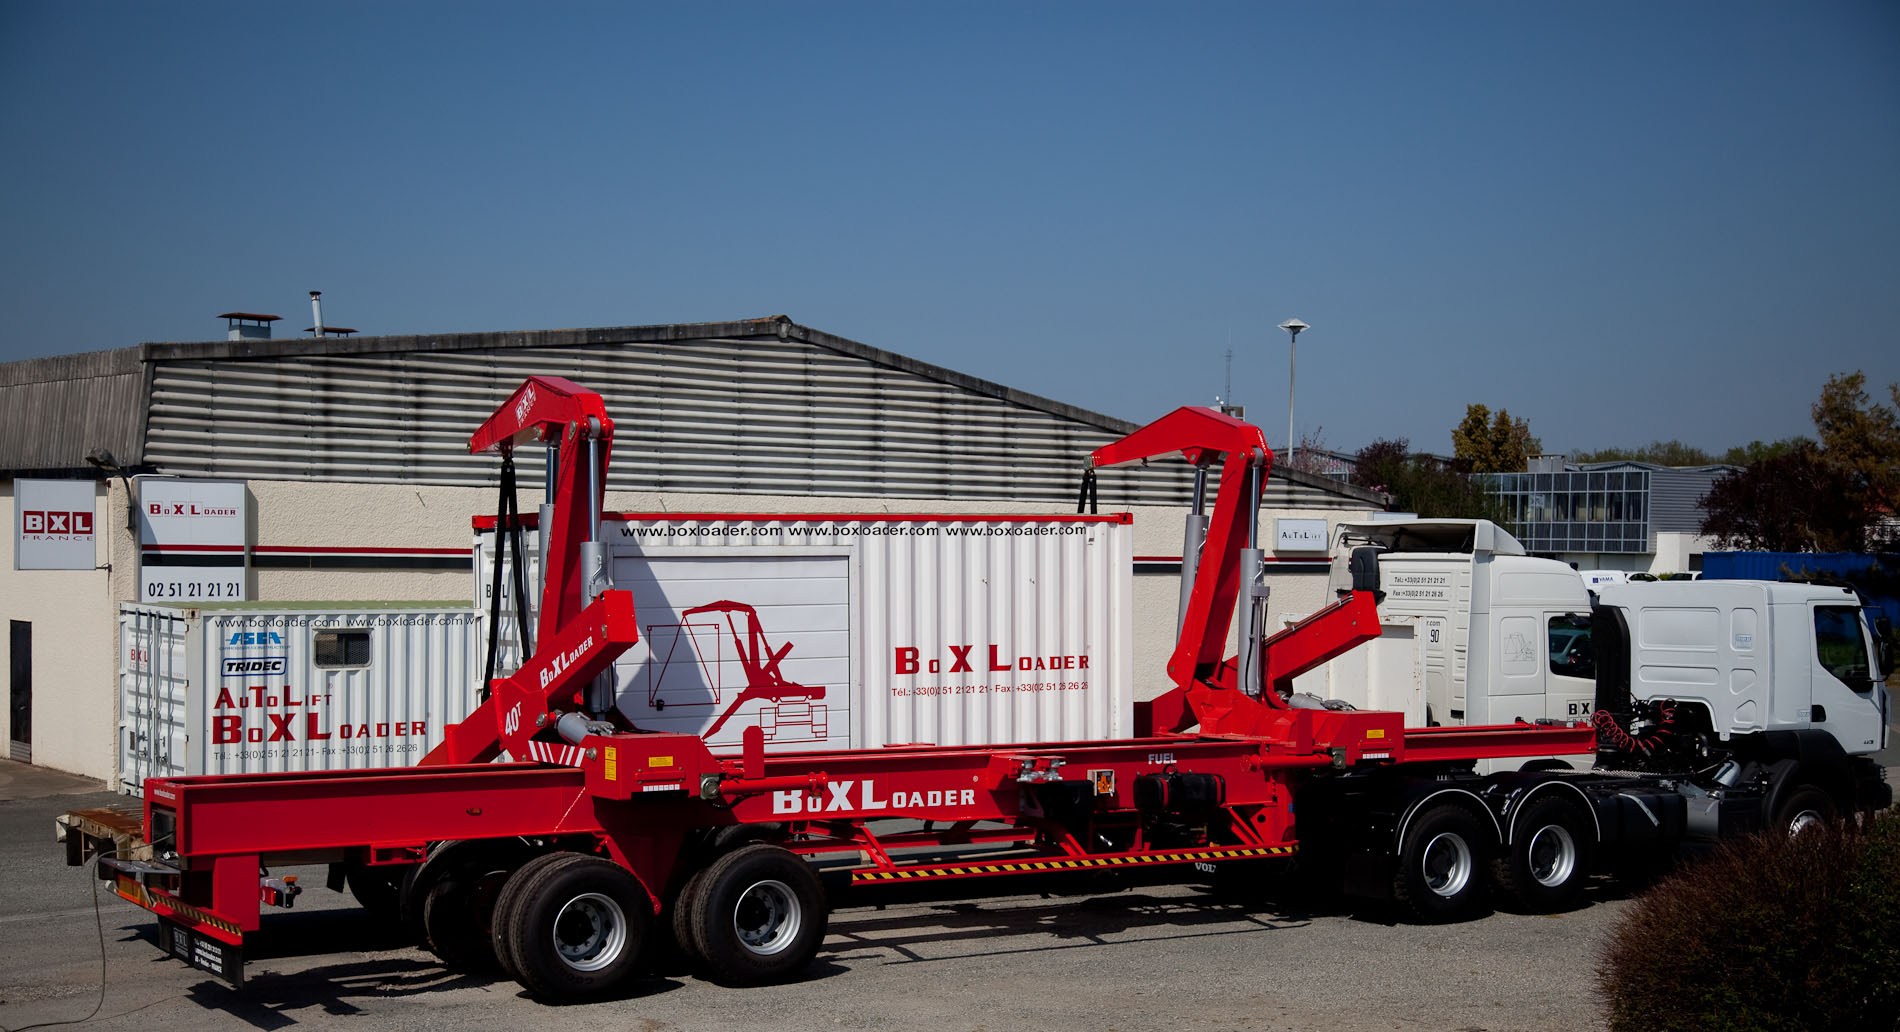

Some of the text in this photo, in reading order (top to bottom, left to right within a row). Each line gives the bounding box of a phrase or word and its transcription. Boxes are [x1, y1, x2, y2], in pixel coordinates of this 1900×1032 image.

[25, 513, 91, 532] BXL
[621, 524, 1086, 537] www.boxloader.com www.boxloader.com www.boxloader.com
[149, 582, 239, 597] 02 51 21 21 21
[215, 618, 340, 628] www.boxloader.com
[346, 617, 463, 627] www.boxloader.com
[226, 661, 282, 672] TRIDEC
[1148, 753, 1177, 765] FUEL
